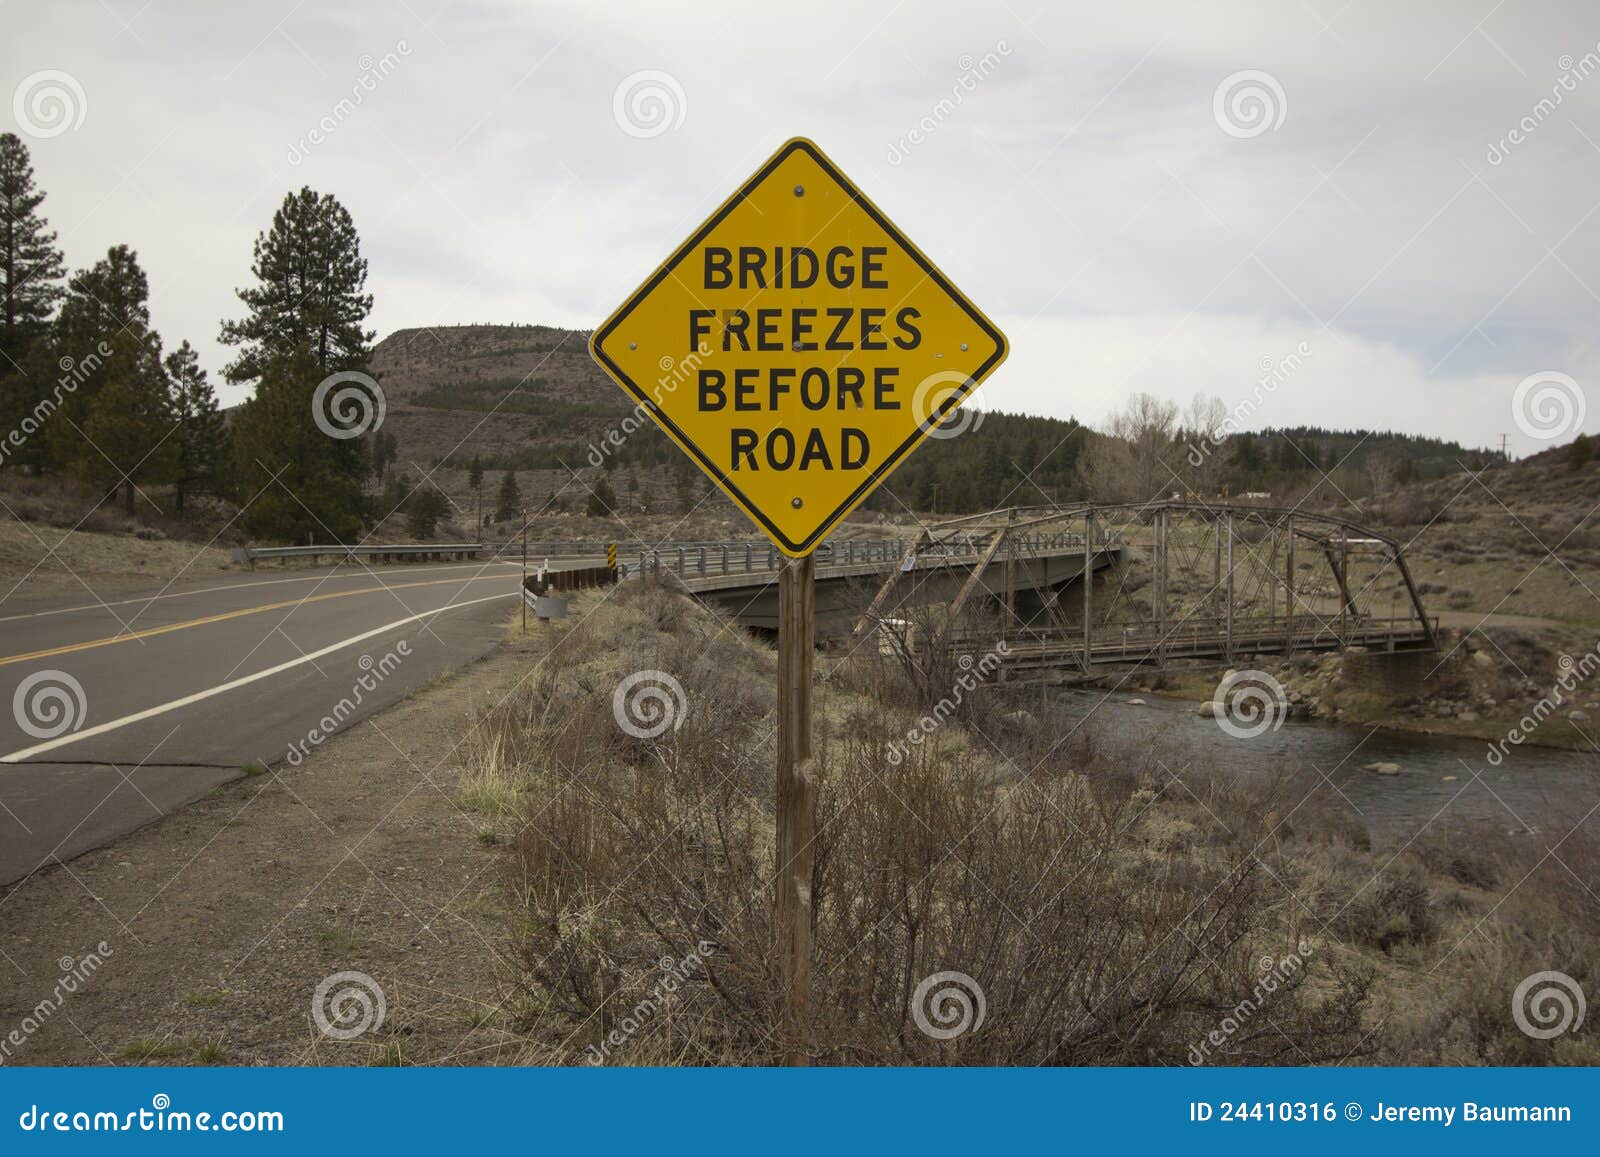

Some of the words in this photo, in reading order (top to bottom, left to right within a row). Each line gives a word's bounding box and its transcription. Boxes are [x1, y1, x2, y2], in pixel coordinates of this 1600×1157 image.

[704, 246, 889, 290] BRIDGE
[689, 307, 922, 352] FREEZES
[698, 367, 901, 412] BEFORE
[731, 428, 870, 472] ROAD
